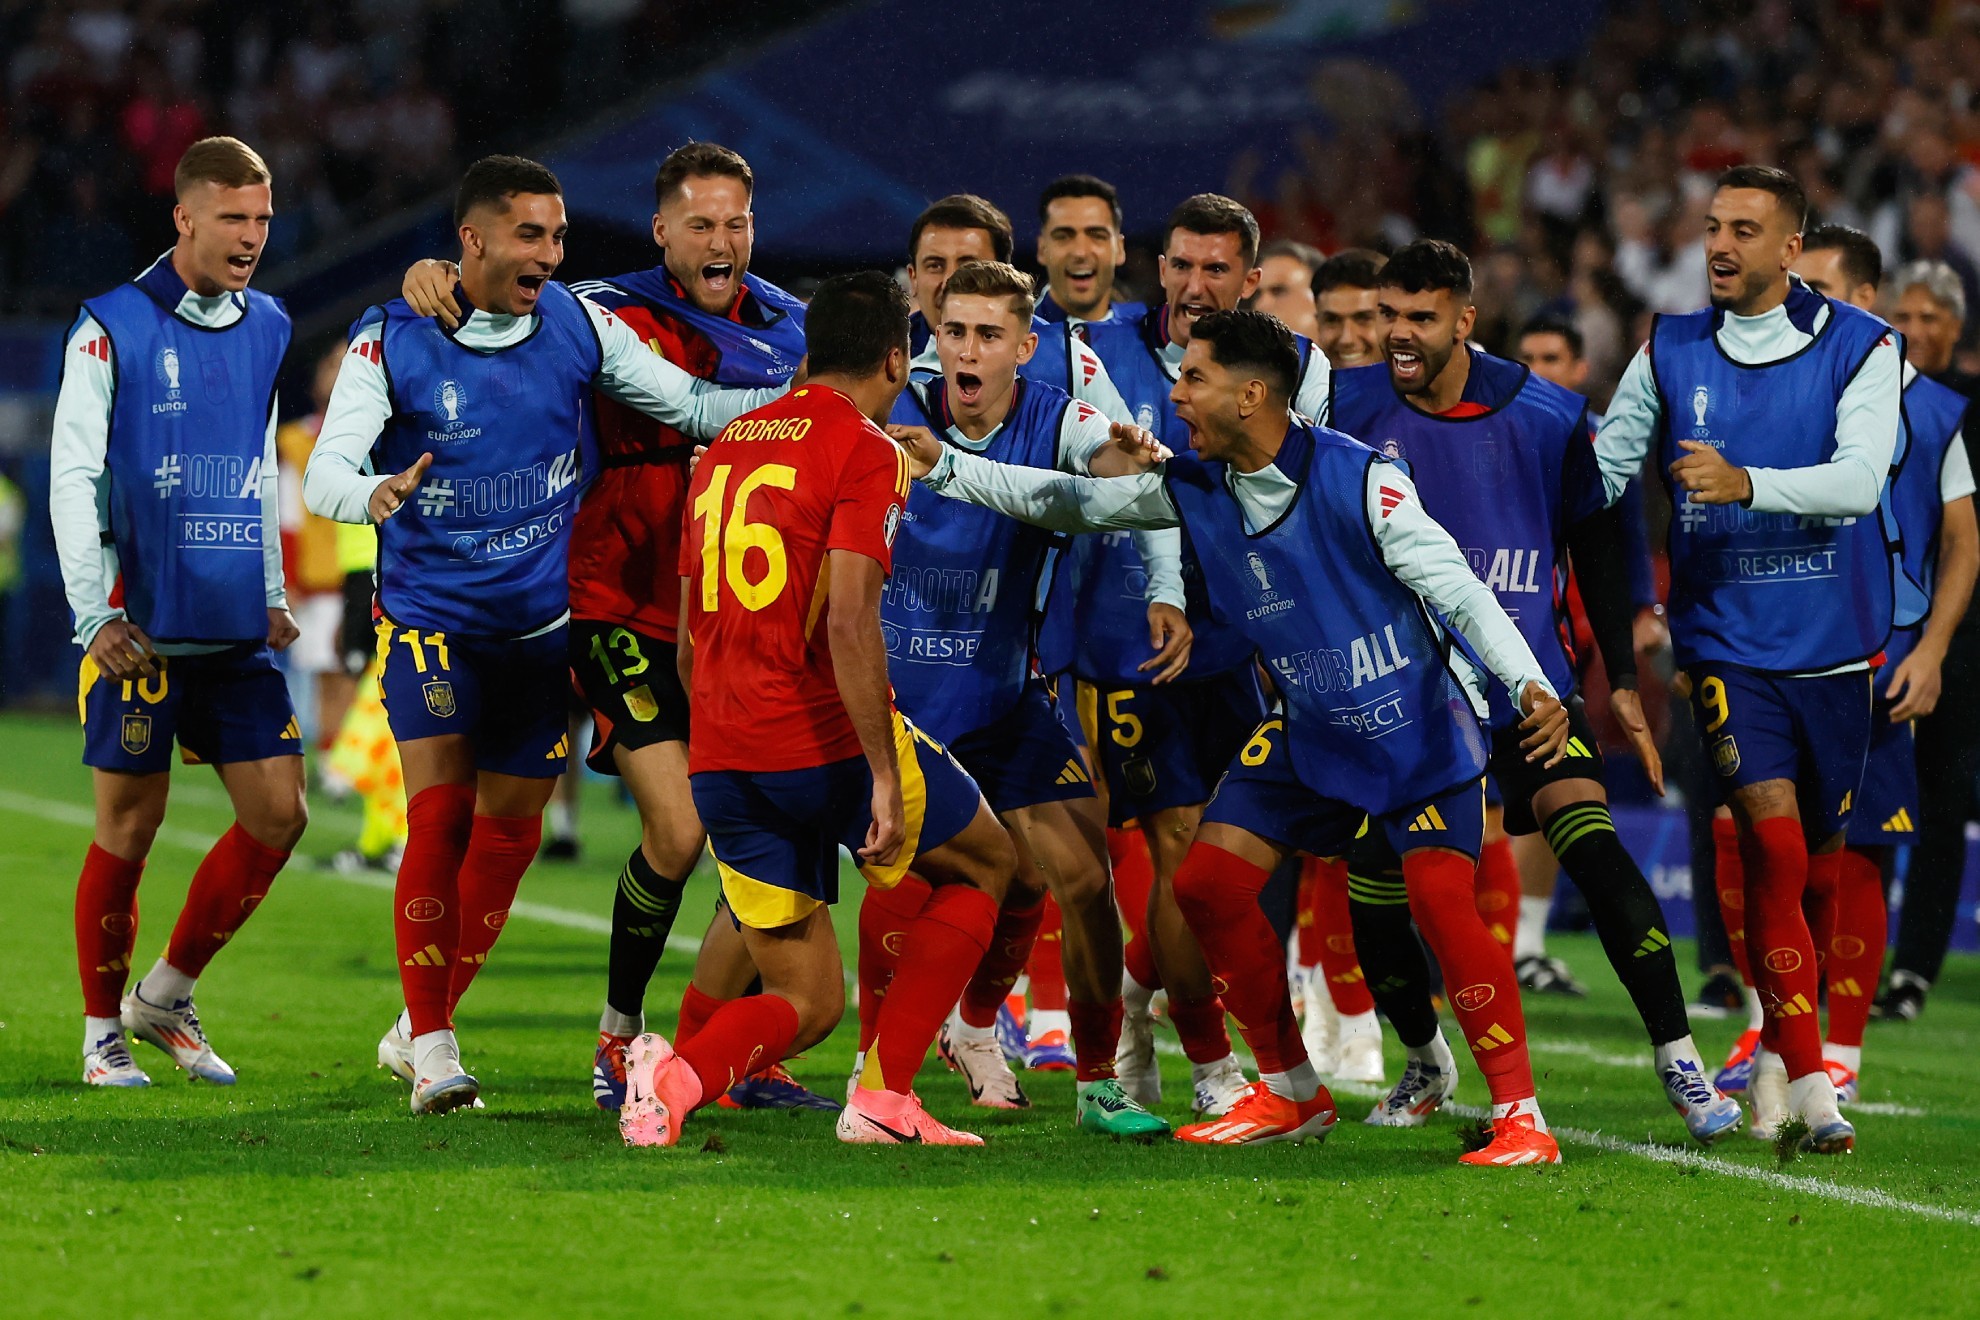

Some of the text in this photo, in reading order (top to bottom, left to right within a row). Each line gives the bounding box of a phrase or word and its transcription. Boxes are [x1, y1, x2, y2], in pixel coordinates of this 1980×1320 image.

[720, 417, 812, 442] RODRIGO
[418, 448, 577, 518] #FOOTBAL
[185, 522, 262, 542] RESPEC
[486, 506, 565, 553] RESPECT
[694, 463, 797, 612] 16
[1738, 551, 1837, 576] RESPECT
[882, 563, 999, 614] FOOTBA
[399, 629, 450, 674] 11
[589, 627, 650, 685] 13
[909, 636, 982, 659] RESPE
[1106, 690, 1143, 748] 5
[1240, 720, 1282, 767] 6
